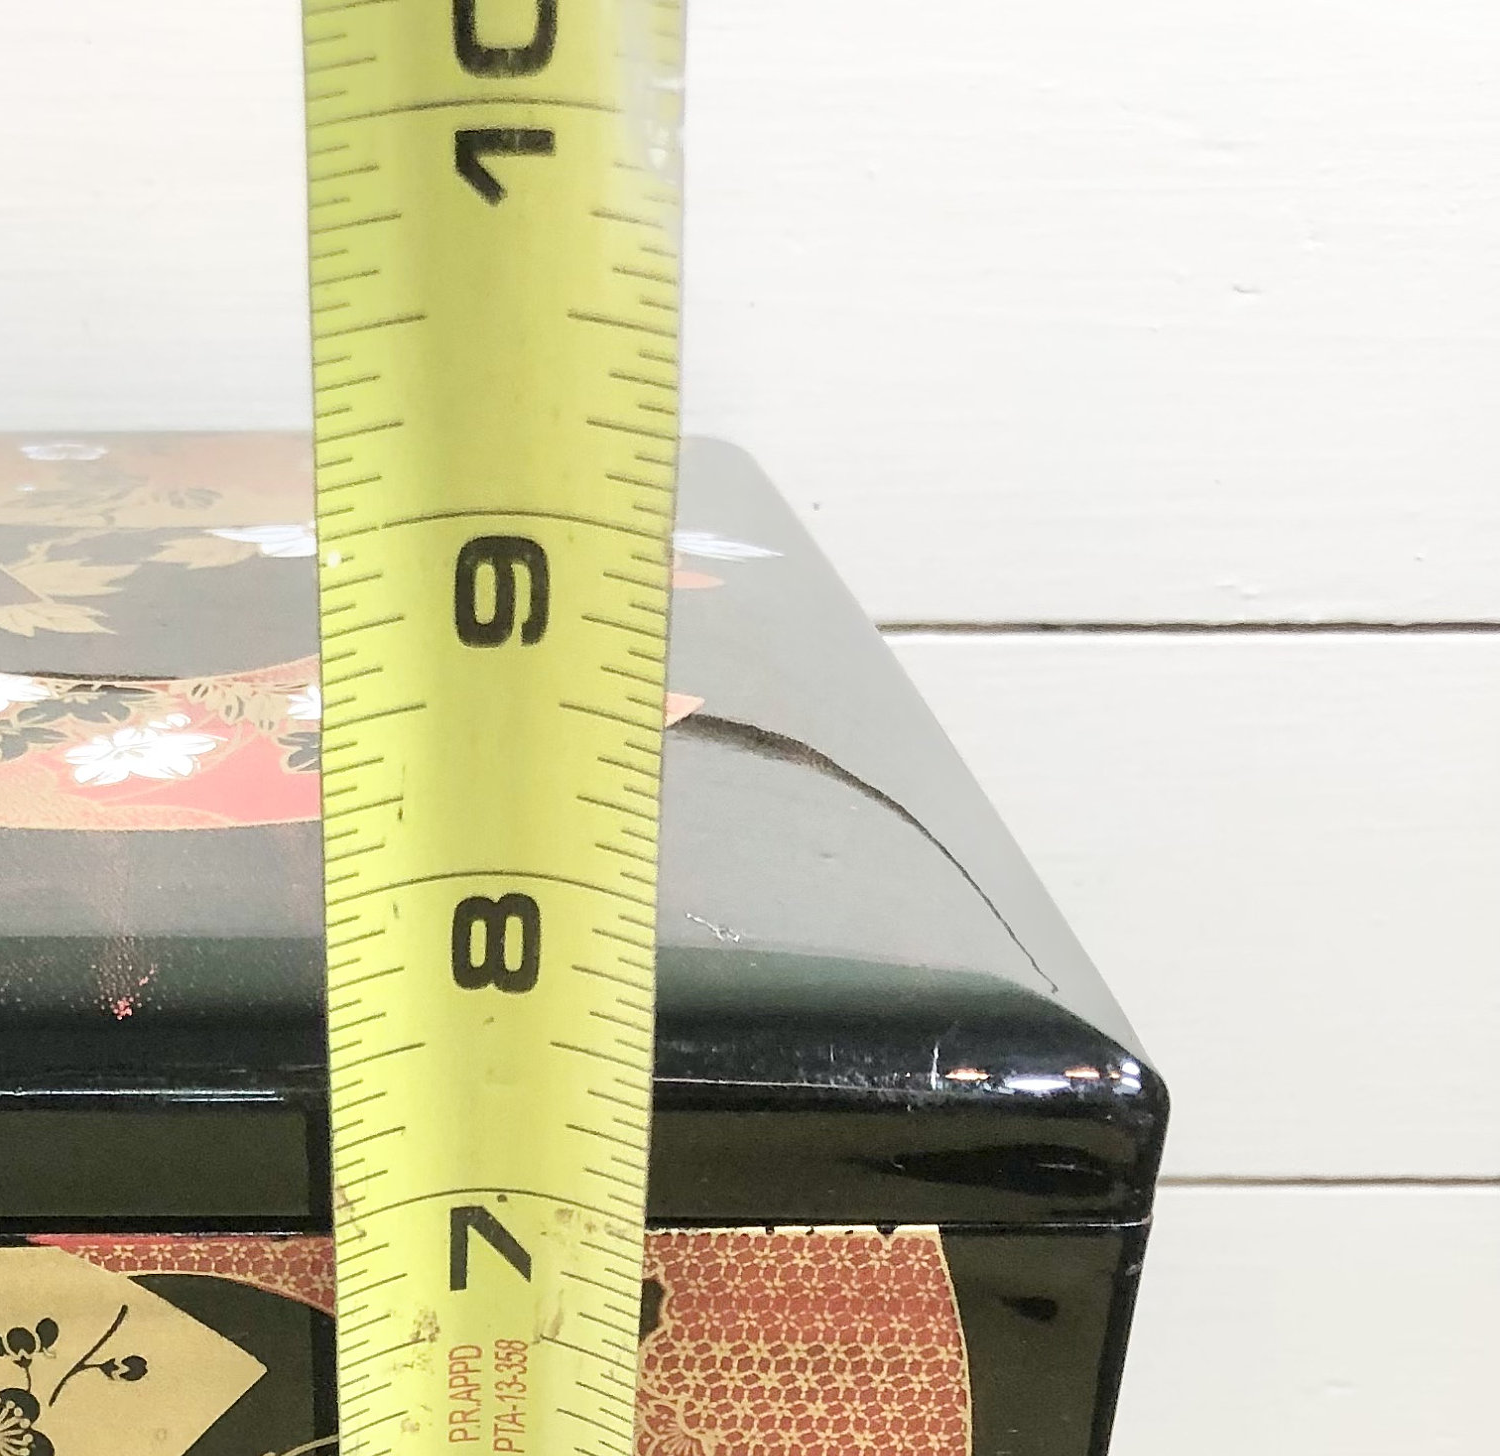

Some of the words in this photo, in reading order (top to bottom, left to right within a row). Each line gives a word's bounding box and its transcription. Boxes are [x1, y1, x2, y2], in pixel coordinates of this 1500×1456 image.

[451, 0, 558, 207] 10
[454, 534, 550, 649] 9
[451, 892, 541, 994] 8
[449, 1205, 532, 1292] 7
[493, 1338, 530, 1454] PTA-13-358
